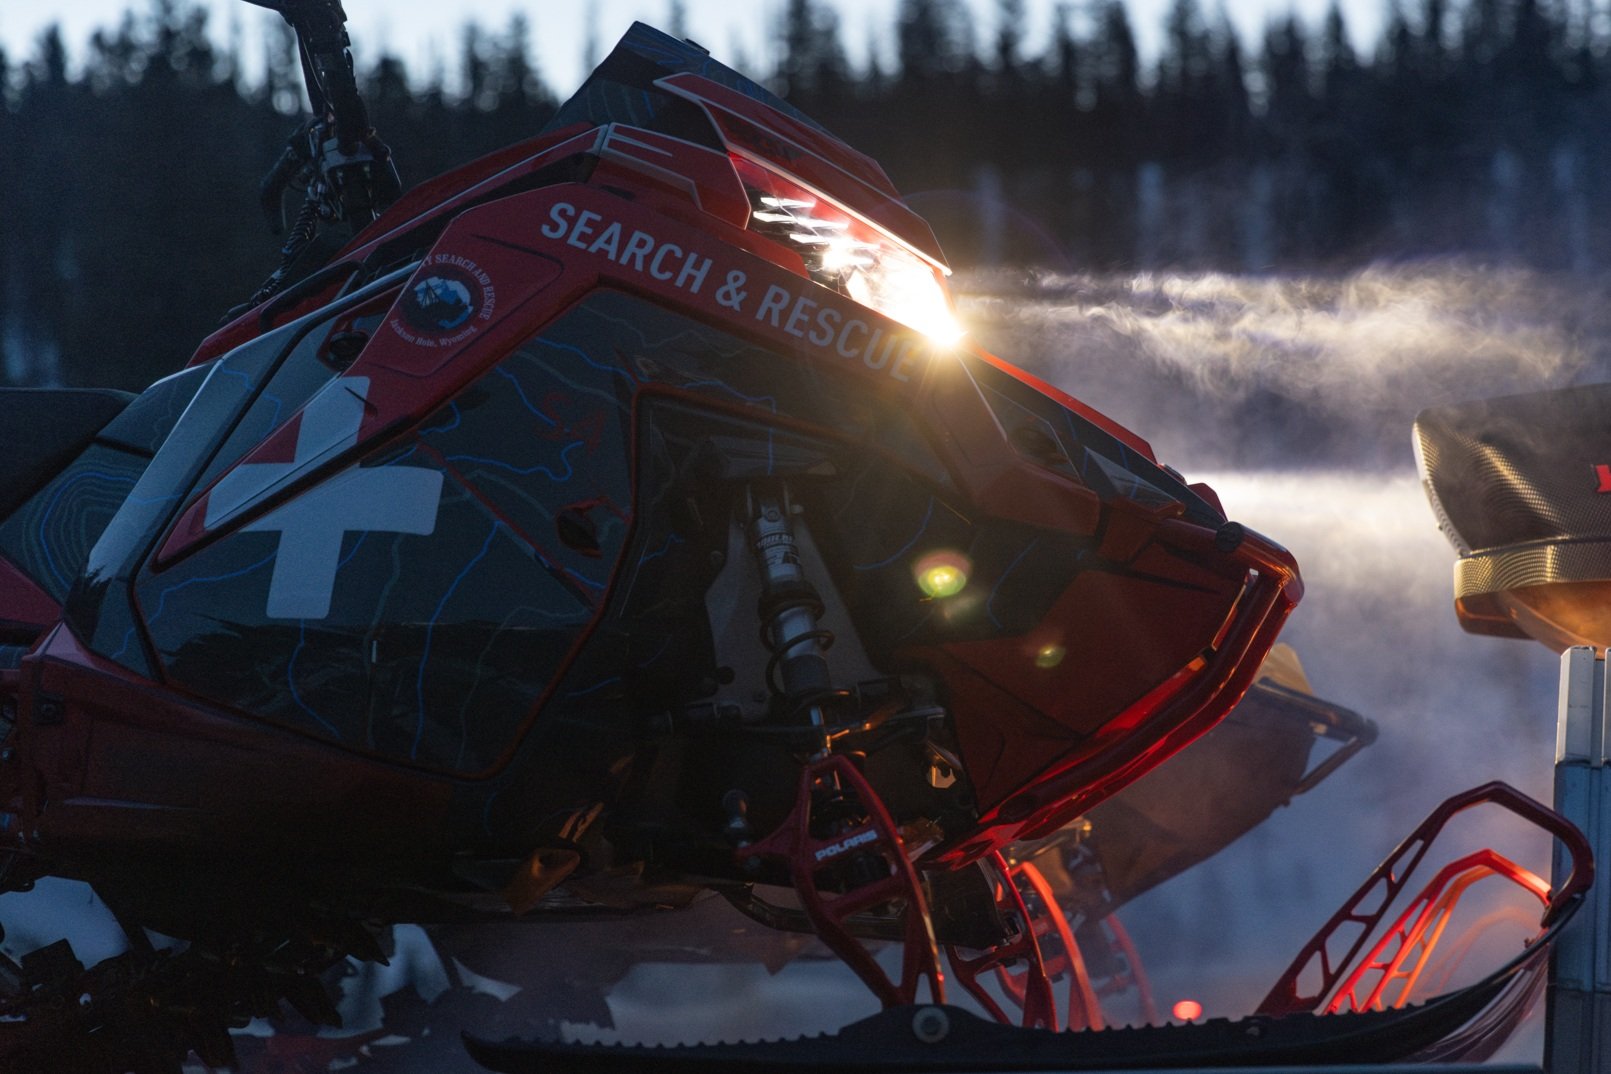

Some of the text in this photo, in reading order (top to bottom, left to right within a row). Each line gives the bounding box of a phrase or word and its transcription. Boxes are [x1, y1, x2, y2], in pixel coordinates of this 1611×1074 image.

[435, 253, 477, 271] SEARCH
[472, 268, 491, 286] AND
[479, 286, 496, 320] RESCUE
[541, 202, 923, 384] SEARCH & RESCUE
[439, 325, 478, 347] Wyoming
[815, 829, 878, 861] POLARIS
